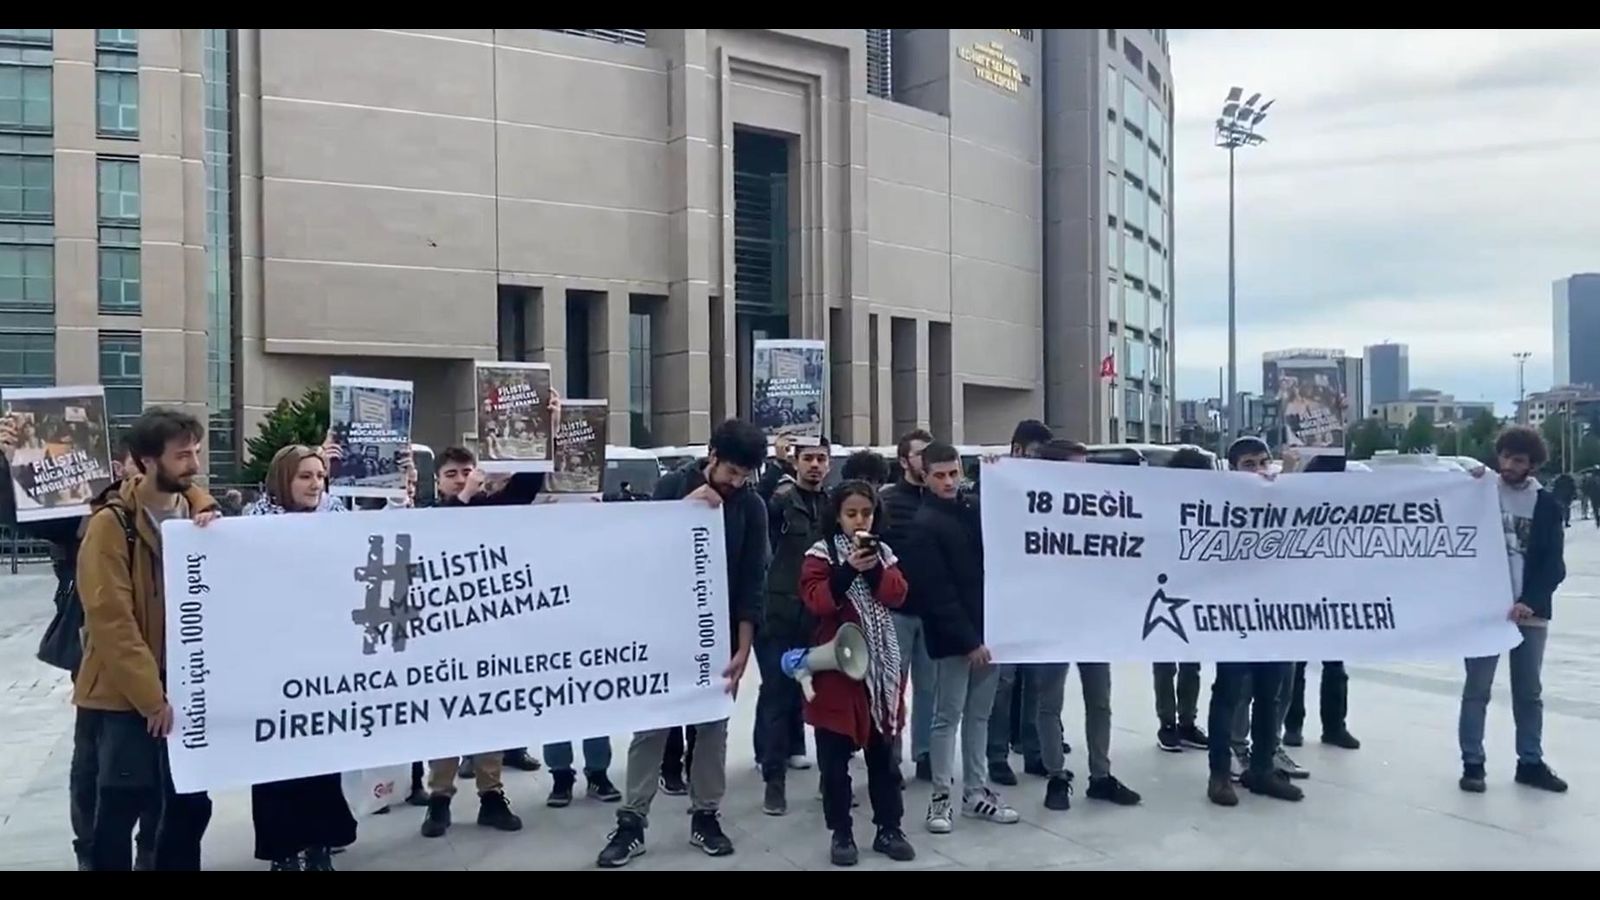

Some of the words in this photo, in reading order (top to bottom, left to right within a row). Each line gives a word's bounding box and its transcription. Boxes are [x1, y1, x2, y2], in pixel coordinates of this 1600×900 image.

[497, 383, 531, 397] FİLİSTİN
[497, 390, 538, 402] MÜCADELESİ
[1026, 490, 1053, 514] 18
[1062, 490, 1143, 519] DEĞİL
[1180, 499, 1287, 528] FİLİSTİN
[1292, 498, 1444, 527] MÜCADELESİ
[691, 526, 711, 576] filistin
[1024, 527, 1145, 558] BİNLERİZ
[1179, 526, 1478, 561] YARGILANAMAZ
[186, 552, 210, 596] genç
[388, 563, 534, 617] MÜCADELESİ
[693, 579, 713, 608] için
[179, 600, 204, 645] 1000
[373, 584, 571, 645] YARGILANAMAZ!
[698, 612, 716, 649] 1000
[1193, 597, 1396, 639] GENÇLİKKOMİTELERİ
[181, 648, 210, 685] için
[282, 670, 399, 699] ONLARCA
[406, 657, 469, 687] DEĞİL
[476, 653, 572, 678] BİNLERCE
[579, 640, 649, 668] GENCİZ
[694, 652, 711, 688] genç
[182, 687, 209, 750] filistin
[254, 700, 430, 742] DİRENİŞTEN
[440, 672, 670, 720] VAZGEÇMİYORUZ!
